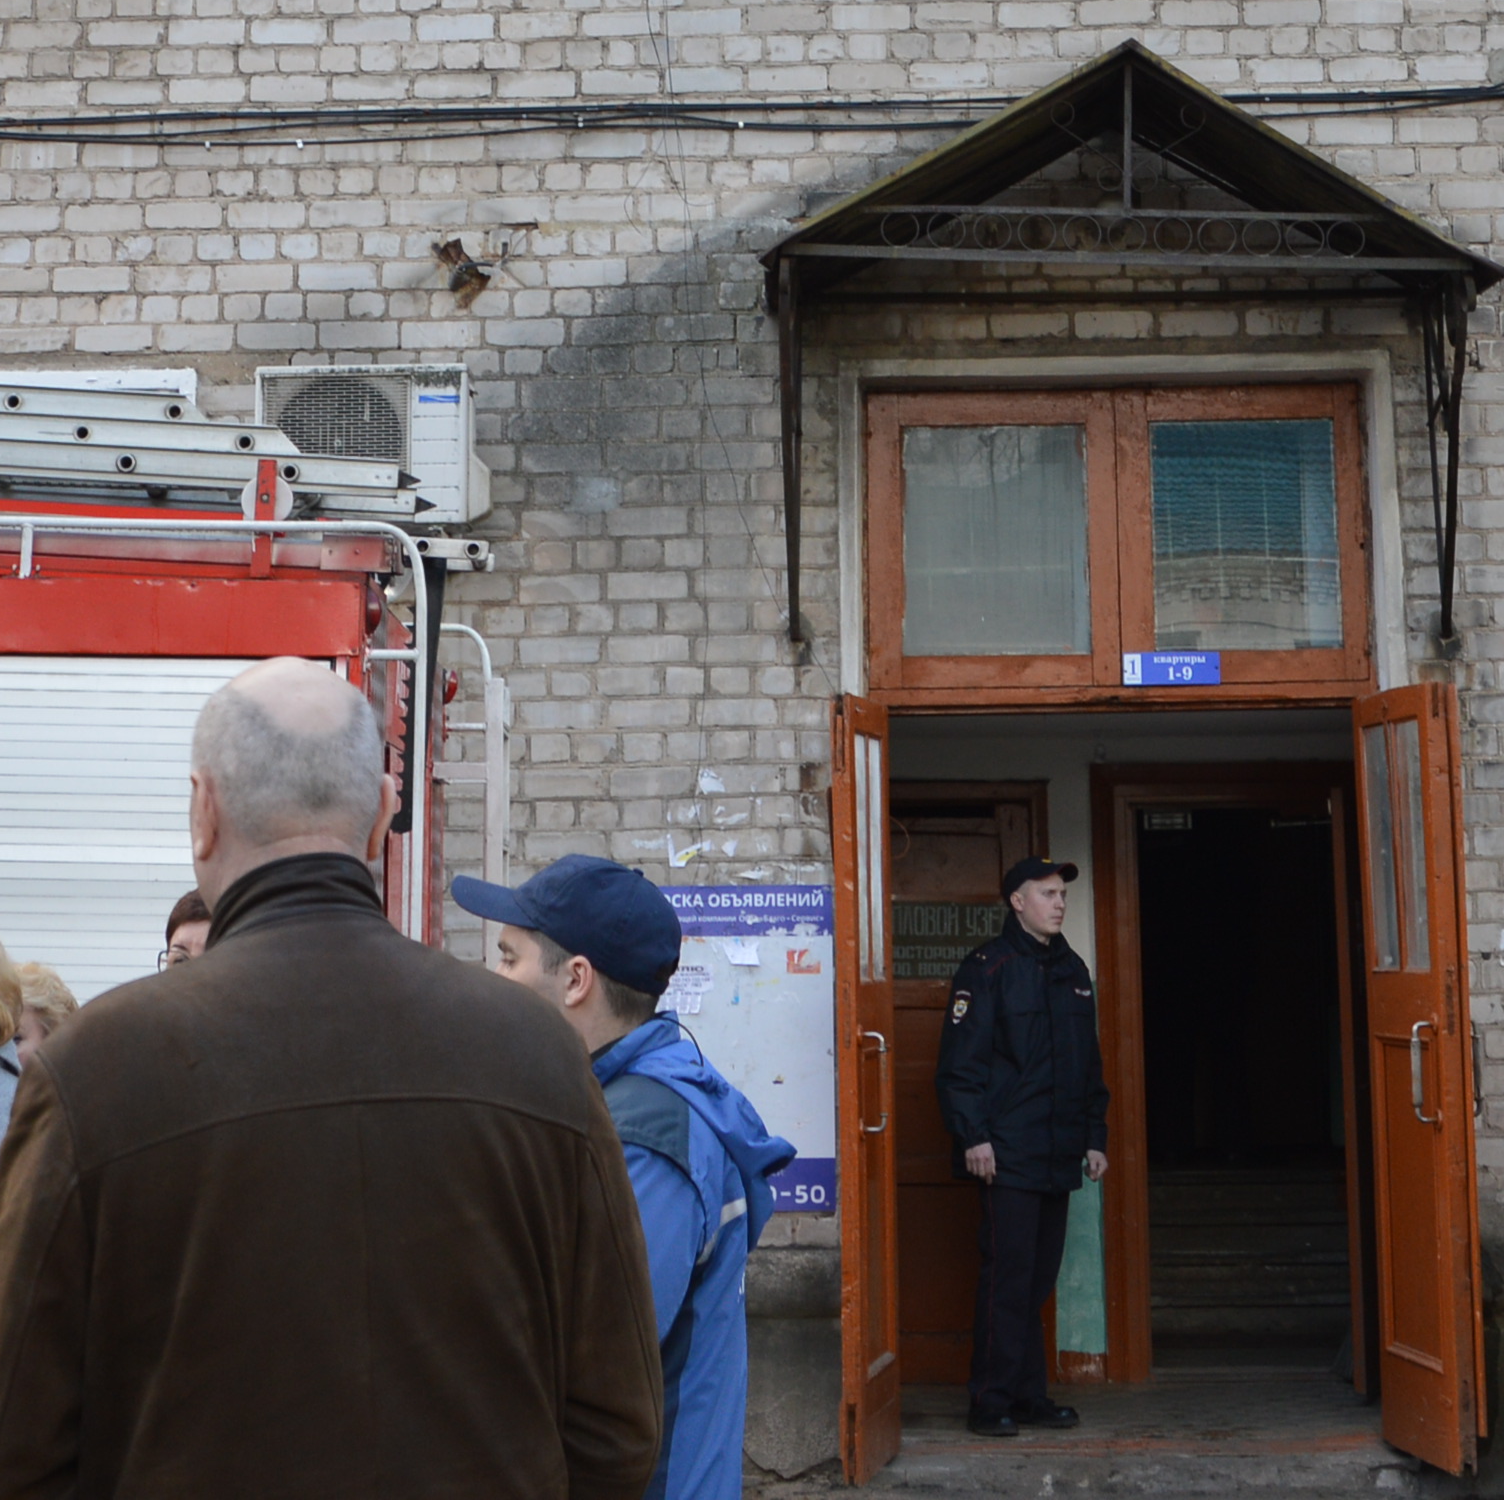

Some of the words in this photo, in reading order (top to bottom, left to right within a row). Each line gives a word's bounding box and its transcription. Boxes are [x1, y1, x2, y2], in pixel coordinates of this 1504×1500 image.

[1128, 658, 1138, 676] 1
[1153, 655, 1207, 665] квартиры
[1168, 666, 1193, 681] 1-9
[708, 889, 824, 908] ОБЪЯВЛЕНИЙ
